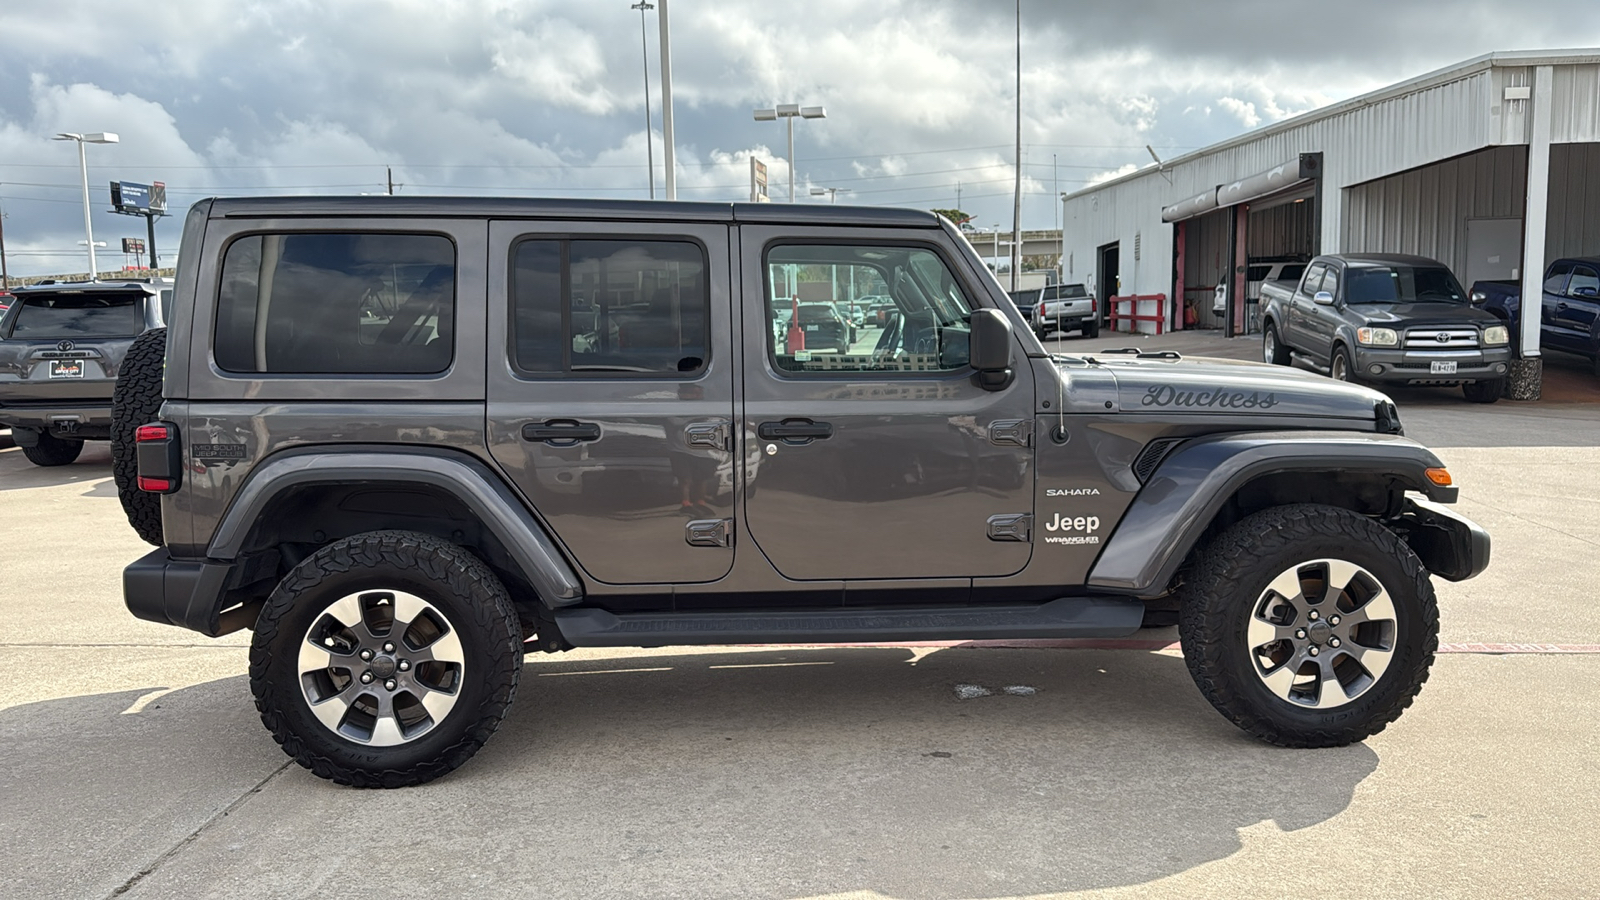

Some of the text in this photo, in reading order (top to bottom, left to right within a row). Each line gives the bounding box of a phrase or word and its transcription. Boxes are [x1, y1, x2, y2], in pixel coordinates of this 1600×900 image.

[1141, 384, 1279, 409] Duchess
[1046, 488, 1100, 496] SAHARA
[1045, 512, 1100, 534] Jeep
